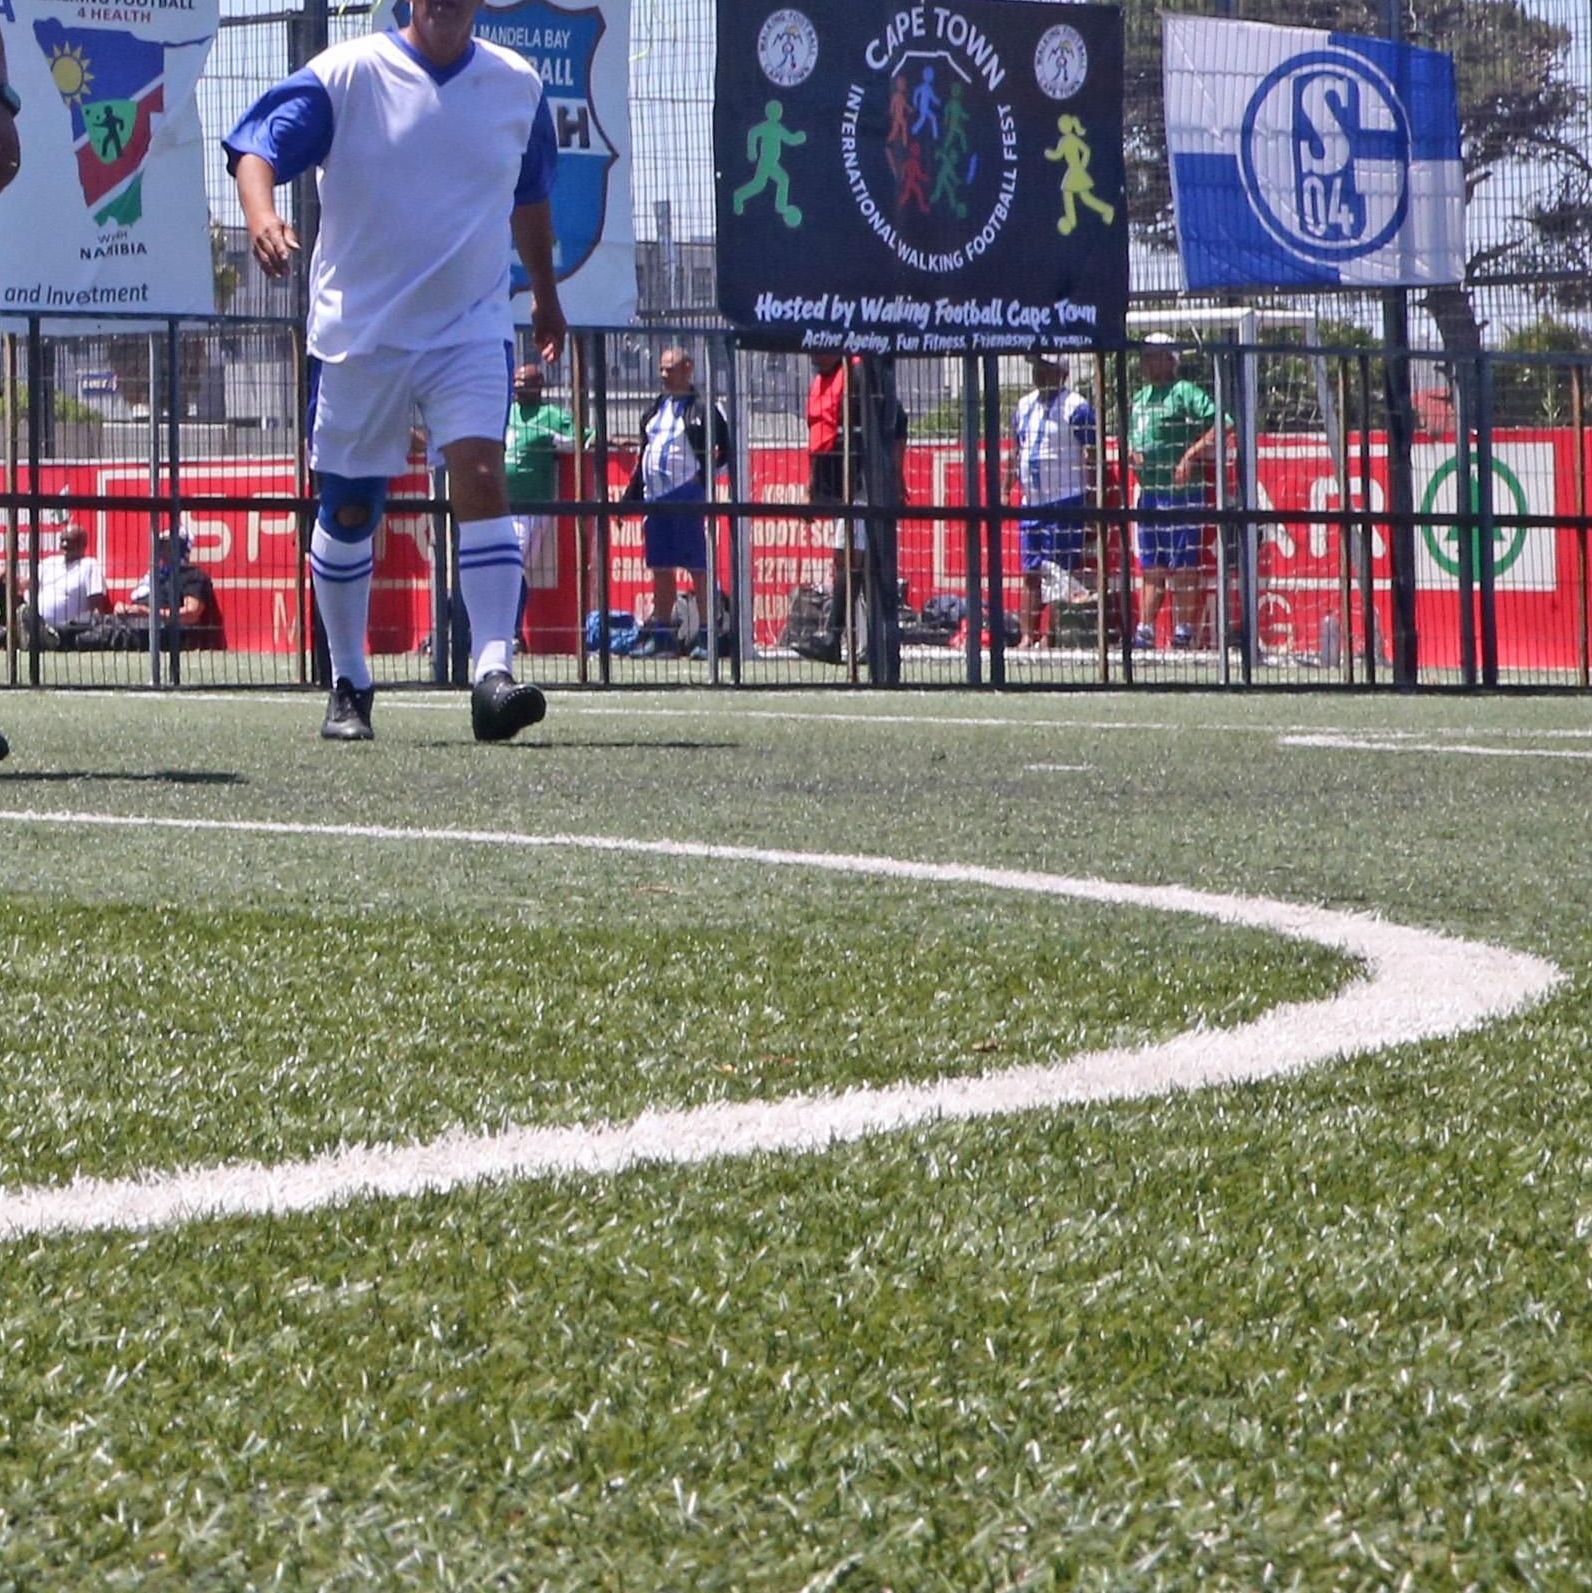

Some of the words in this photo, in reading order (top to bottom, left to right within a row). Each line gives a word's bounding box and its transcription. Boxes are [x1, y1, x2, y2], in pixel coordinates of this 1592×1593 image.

[76, 6, 87, 20] 4
[90, 8, 153, 24] HEALTH
[479, 24, 542, 47] MANDELA
[544, 28, 572, 50] BAY
[865, 6, 927, 71] CAPE
[933, 6, 1007, 92] TOWN
[841, 83, 897, 251] INTERNATIONAL
[896, 238, 965, 273] WALKING
[965, 167, 1018, 262] FOOTBALL
[996, 103, 1018, 162] FEST
[4, 283, 42, 304] and
[754, 291, 826, 323] Hosted
[831, 293, 856, 328] by
[860, 295, 931, 330] Walking
[934, 297, 1004, 327] Football
[1006, 298, 1051, 333] Cape
[1053, 298, 1098, 326] Town
[801, 329, 843, 349] Active
[895, 332, 921, 352] Fun
[751, 518, 810, 547] ROOTE
